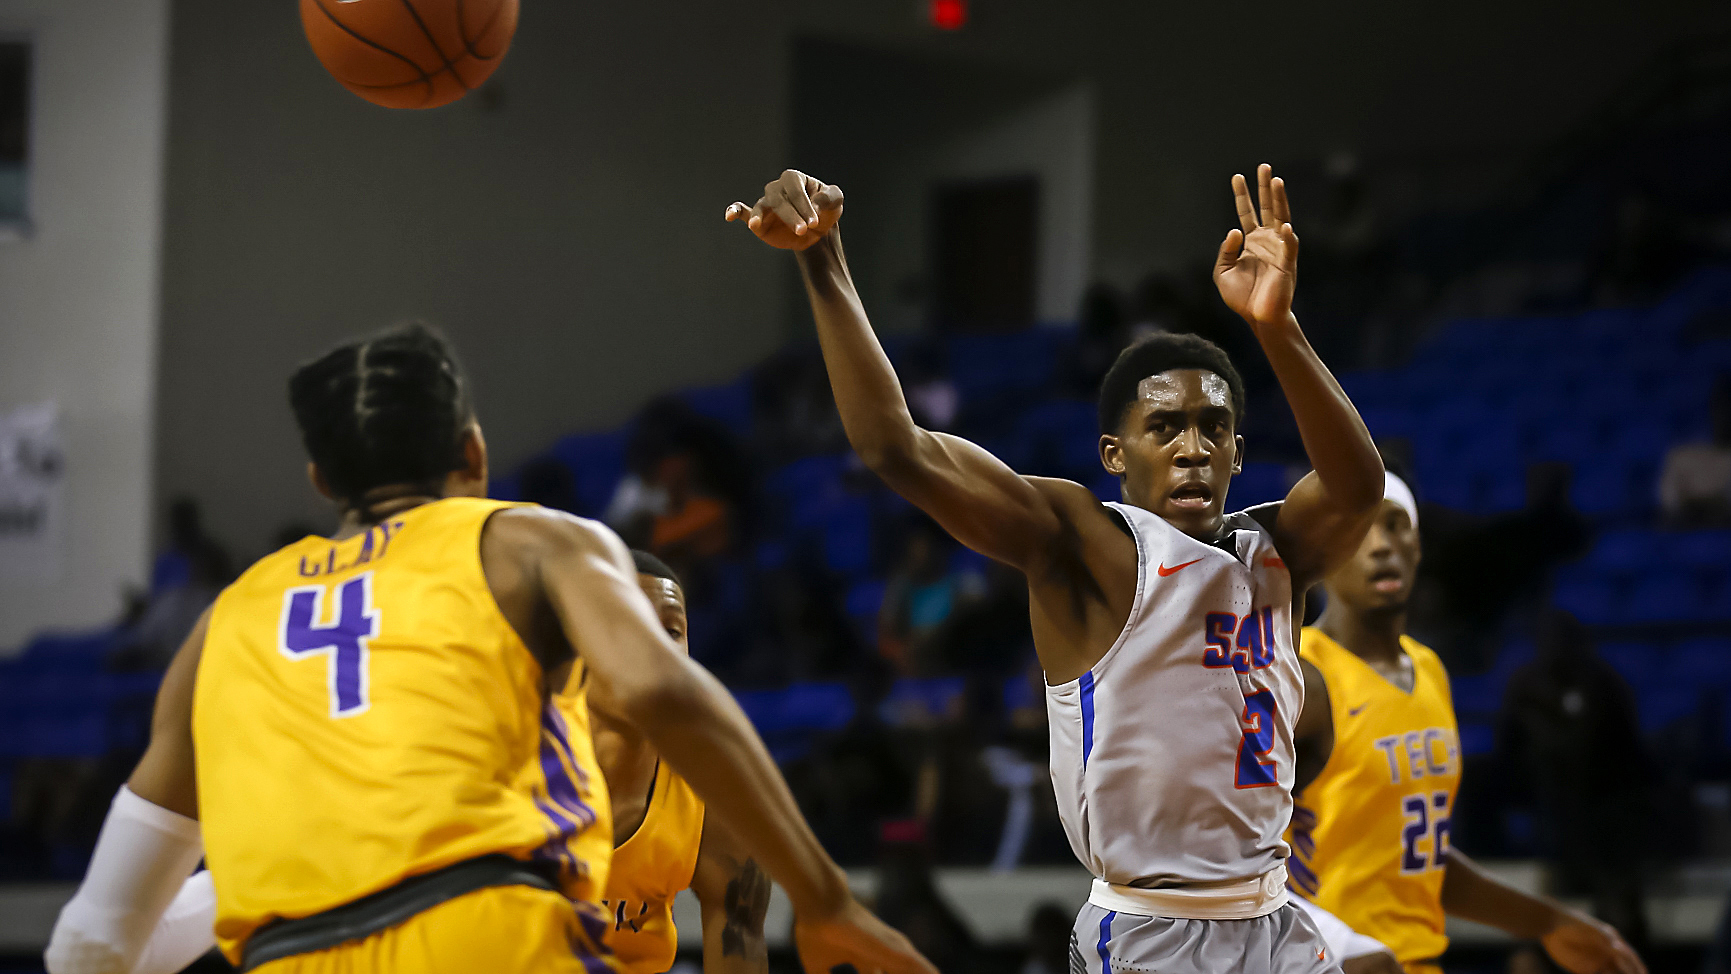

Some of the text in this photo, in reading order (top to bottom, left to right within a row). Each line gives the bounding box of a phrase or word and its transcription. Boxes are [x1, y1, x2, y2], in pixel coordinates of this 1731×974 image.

[278, 570, 381, 719] 4
[1202, 605, 1275, 674] SSU
[1234, 687, 1279, 789] 2
